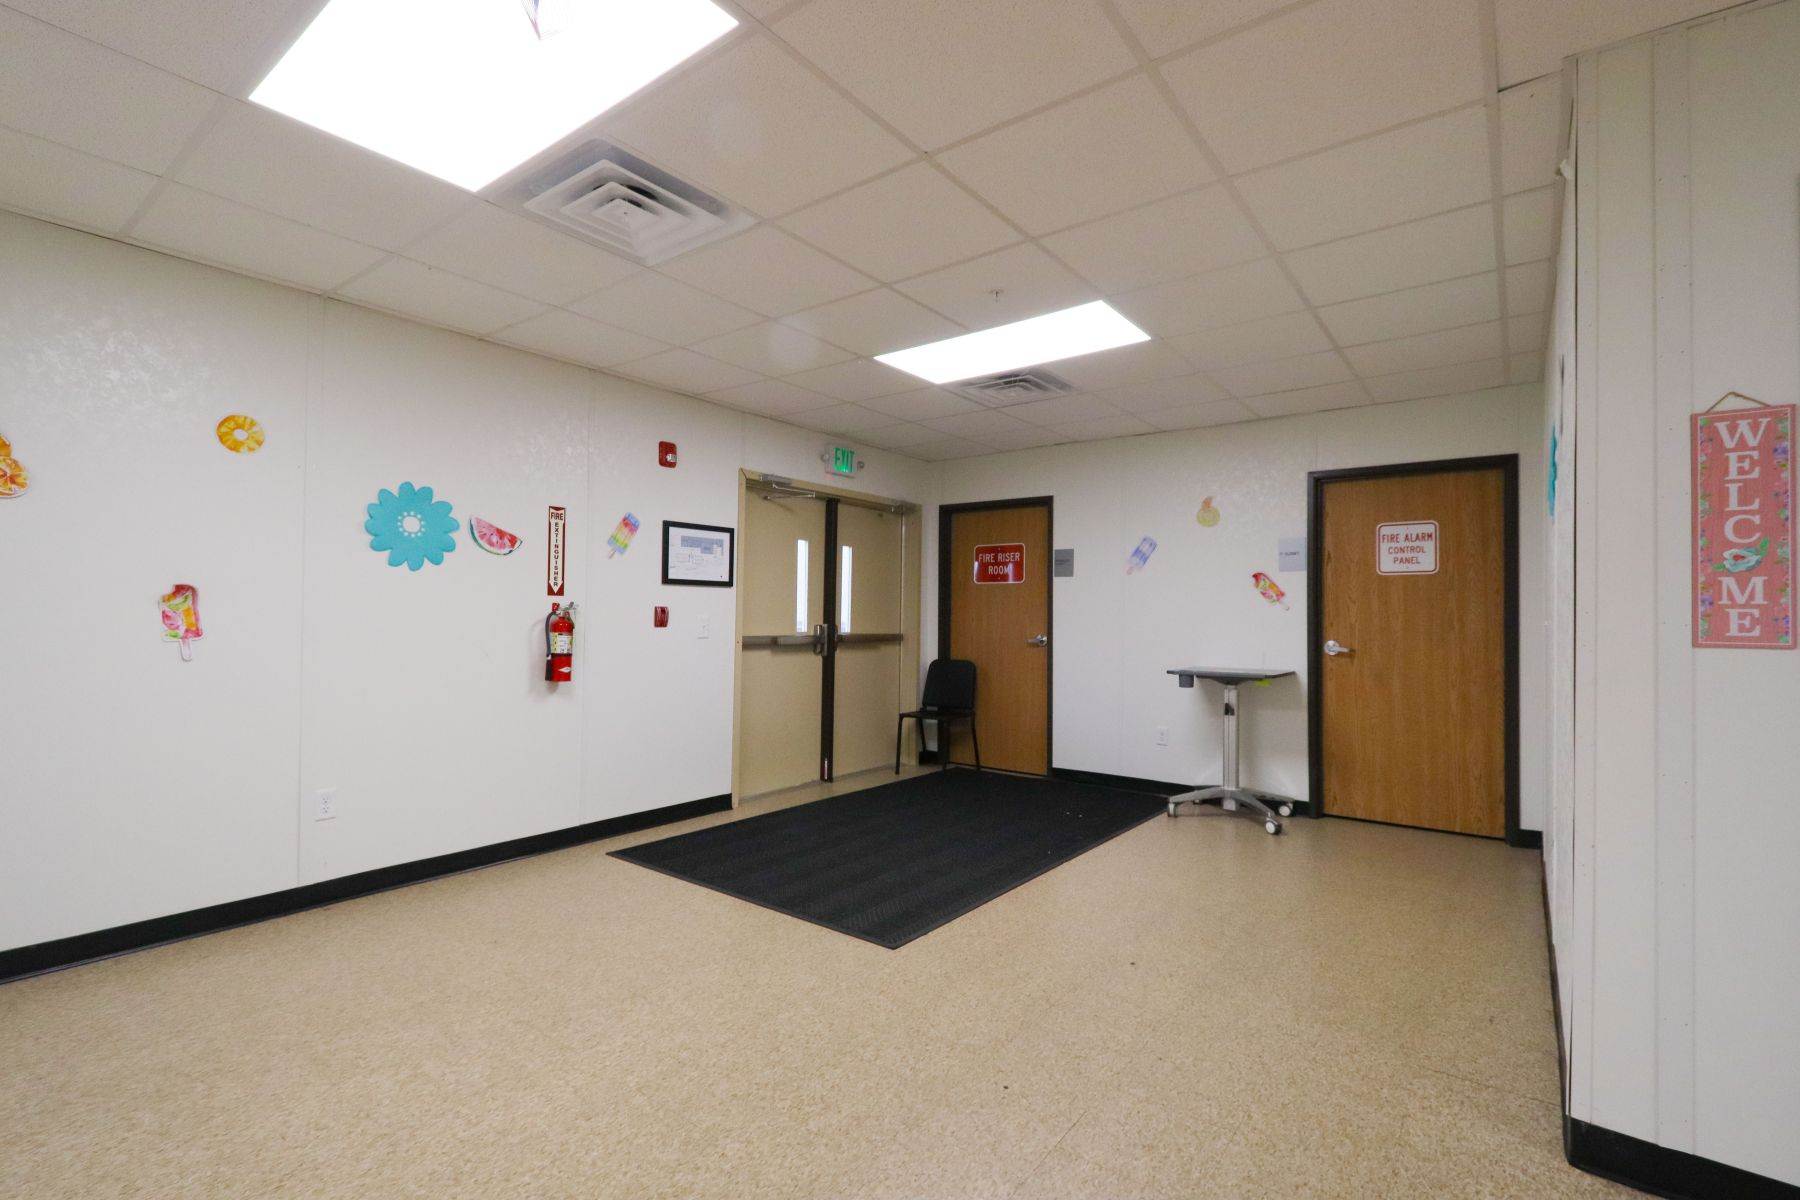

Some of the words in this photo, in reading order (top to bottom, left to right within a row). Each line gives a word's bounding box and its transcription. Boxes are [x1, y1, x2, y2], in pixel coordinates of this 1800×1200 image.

[834, 447, 855, 473] EXIT
[550, 512, 564, 521] FIRE
[1381, 533, 1400, 544] FIRE
[1404, 531, 1433, 543] ALARM
[1388, 545, 1426, 555] CONTROL
[978, 553, 996, 563] FIRE
[997, 552, 1020, 562] RISER
[1393, 556, 1421, 565] PANEL
